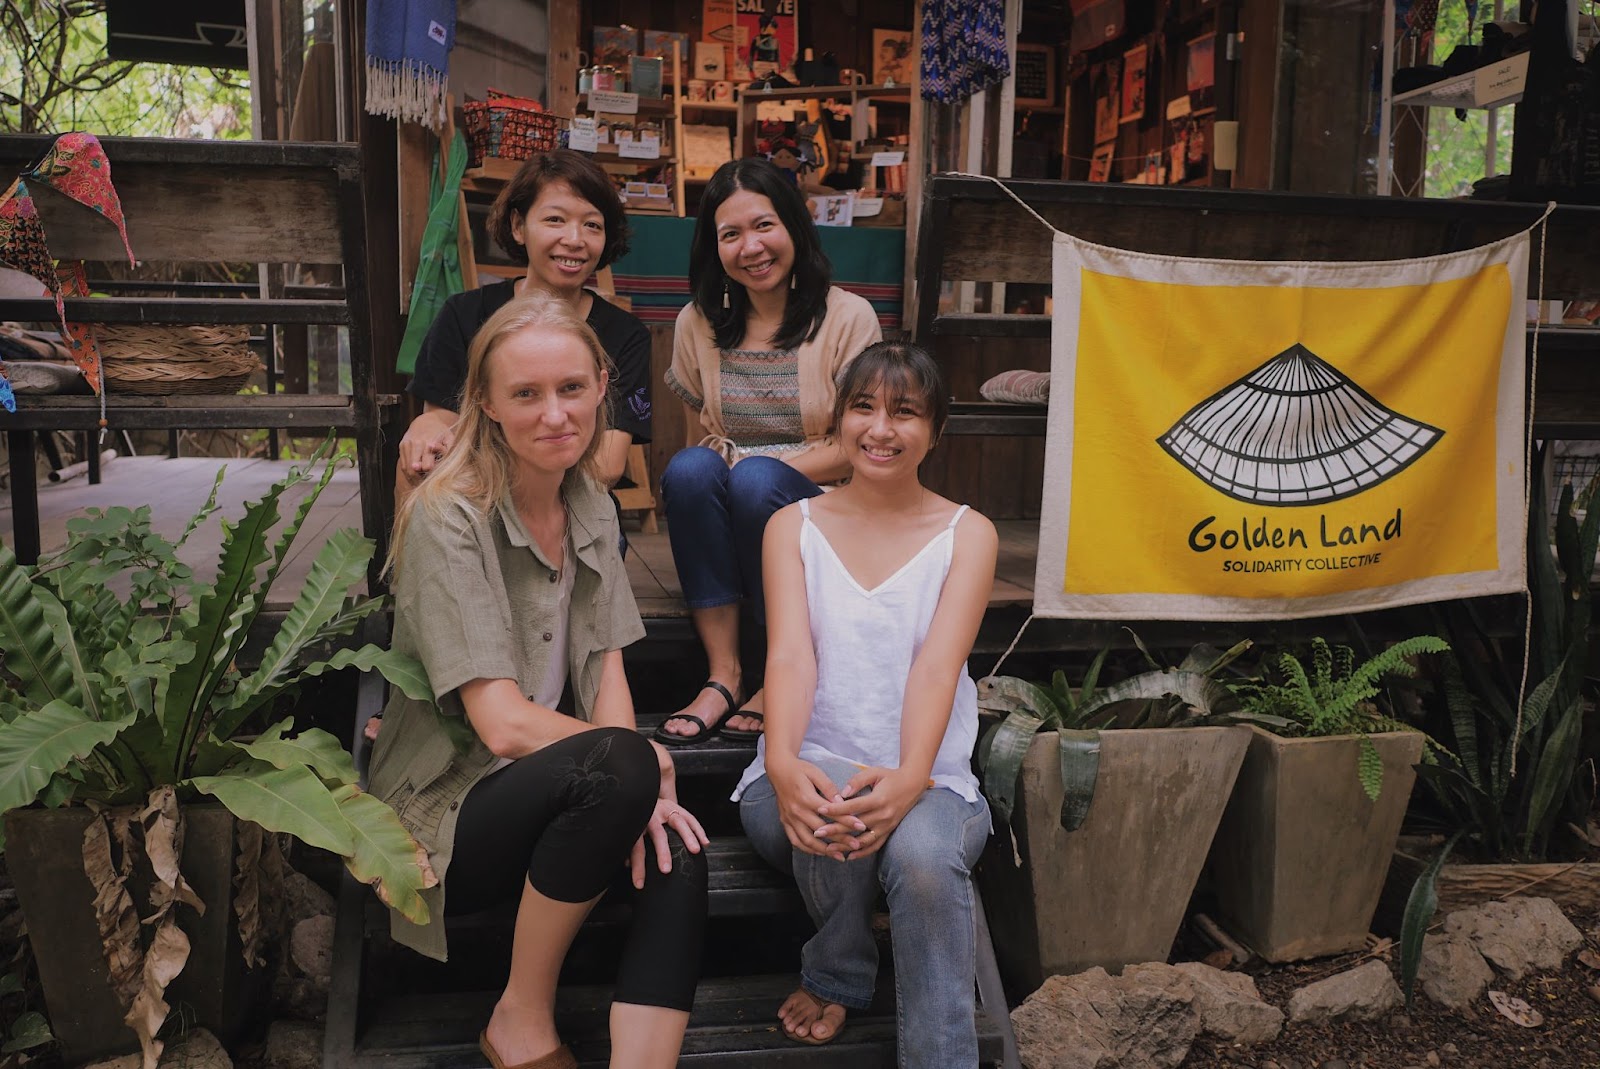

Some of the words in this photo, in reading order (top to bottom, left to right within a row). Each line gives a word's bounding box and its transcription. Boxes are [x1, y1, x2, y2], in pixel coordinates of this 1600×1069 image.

[1188, 515, 1308, 553] Golden
[1320, 508, 1402, 547] Land
[1222, 559, 1303, 573] SOLIDARITY
[1305, 552, 1382, 571] COLLECTIVE
